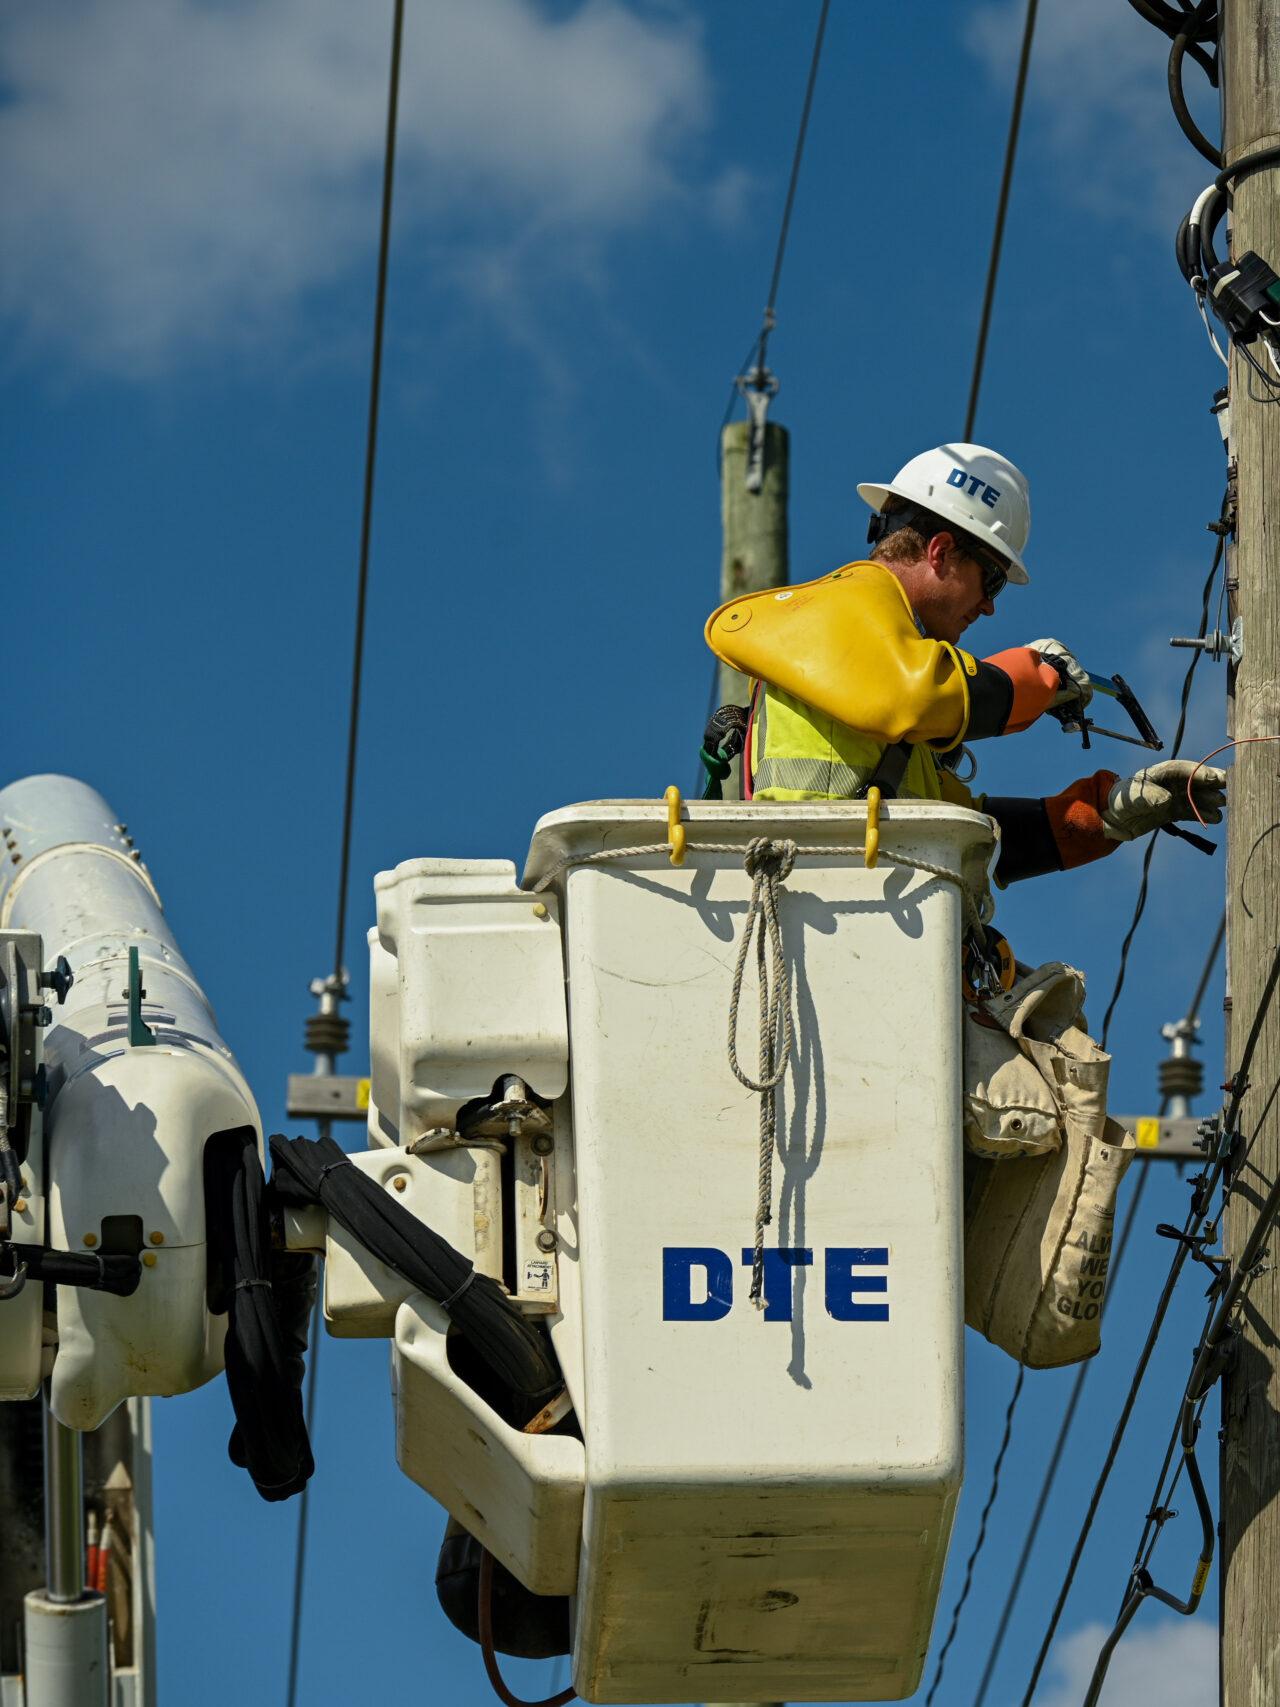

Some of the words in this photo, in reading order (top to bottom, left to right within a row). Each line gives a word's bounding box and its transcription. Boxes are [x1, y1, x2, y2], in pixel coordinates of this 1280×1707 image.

[946, 468, 1001, 509] DTE
[662, 1247, 890, 1322] DTE
[1078, 1278, 1106, 1299] YO
[1057, 1296, 1104, 1320] GLO
